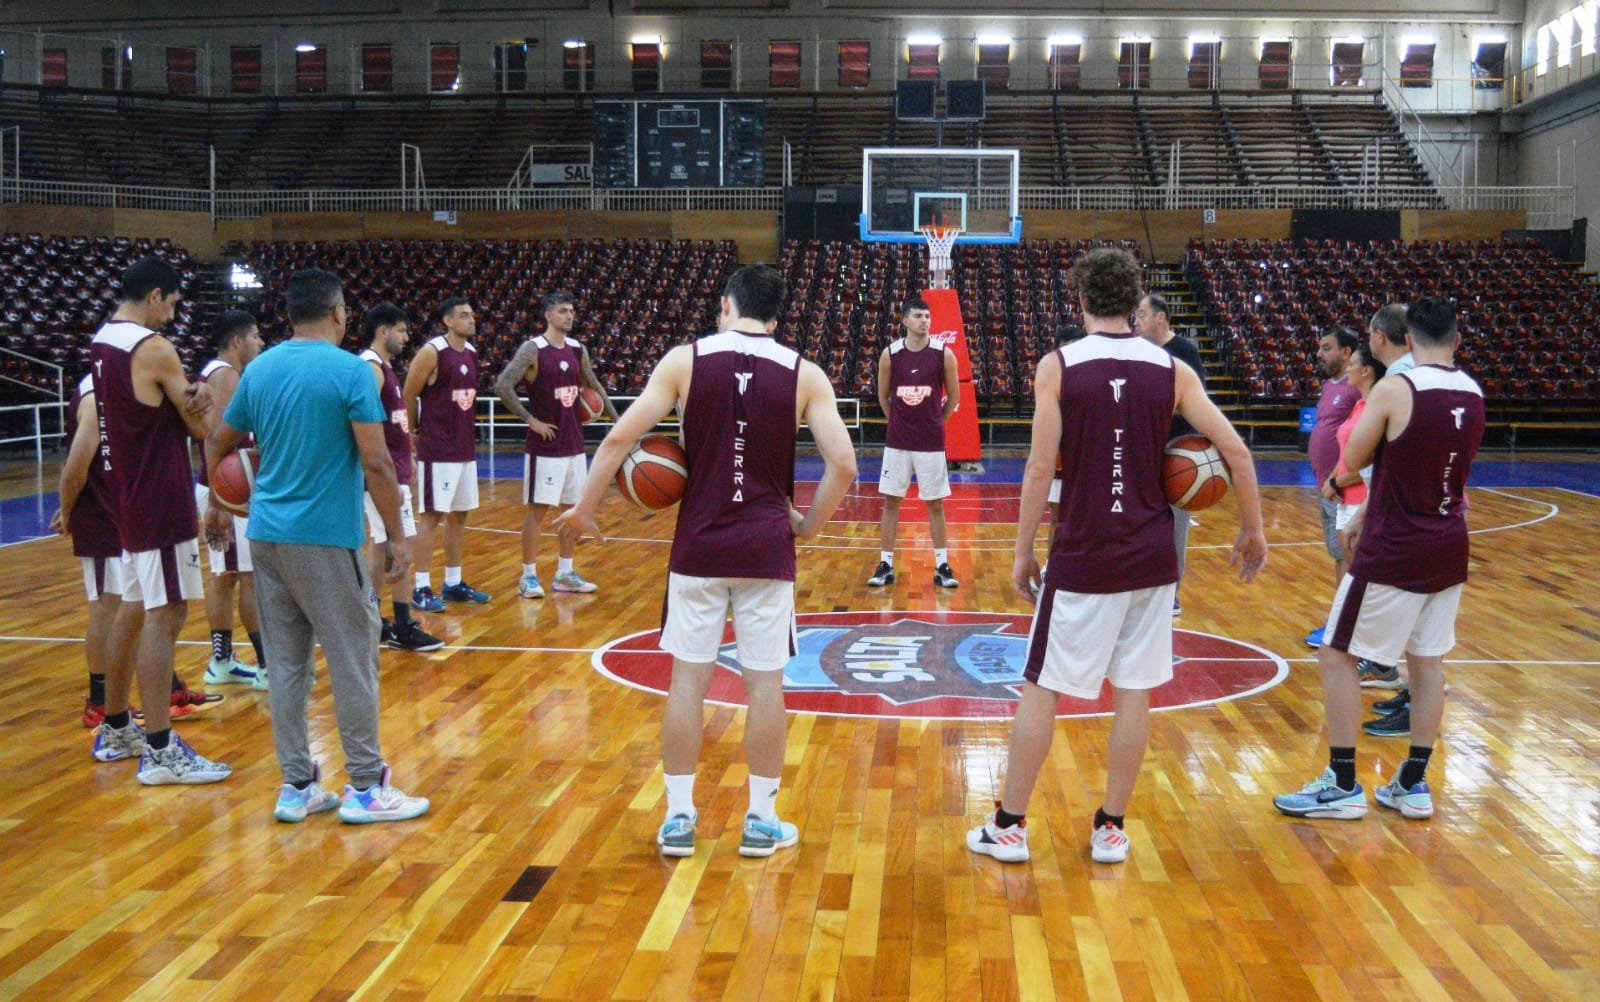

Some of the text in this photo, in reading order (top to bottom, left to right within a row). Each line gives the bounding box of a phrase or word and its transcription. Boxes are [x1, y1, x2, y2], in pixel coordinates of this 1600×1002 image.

[1206, 210, 1214, 222] 8
[732, 420, 748, 502] TERRA
[1110, 429, 1124, 512] TERRA
[844, 636, 936, 683] SALTA
